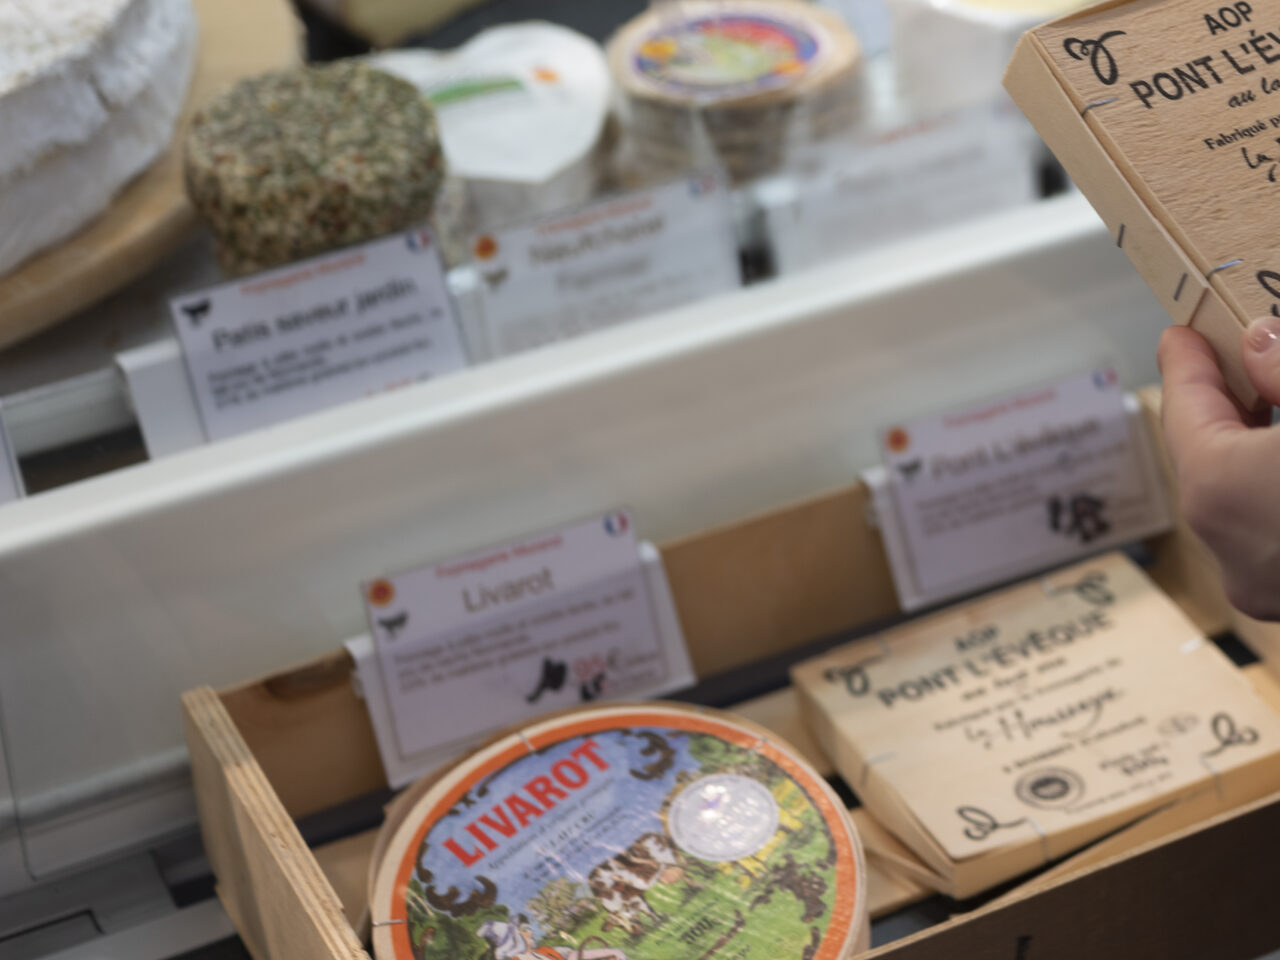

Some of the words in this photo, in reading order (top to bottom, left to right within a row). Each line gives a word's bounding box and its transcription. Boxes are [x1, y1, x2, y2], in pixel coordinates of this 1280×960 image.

[1203, 0, 1253, 35] AOP
[1128, 55, 1224, 109] PONT
[1227, 89, 1256, 108] au
[1203, 120, 1268, 150] Fabriqué
[461, 566, 555, 613] Livarot
[877, 664, 961, 709] PONT
[441, 738, 611, 869] LIVAROT
